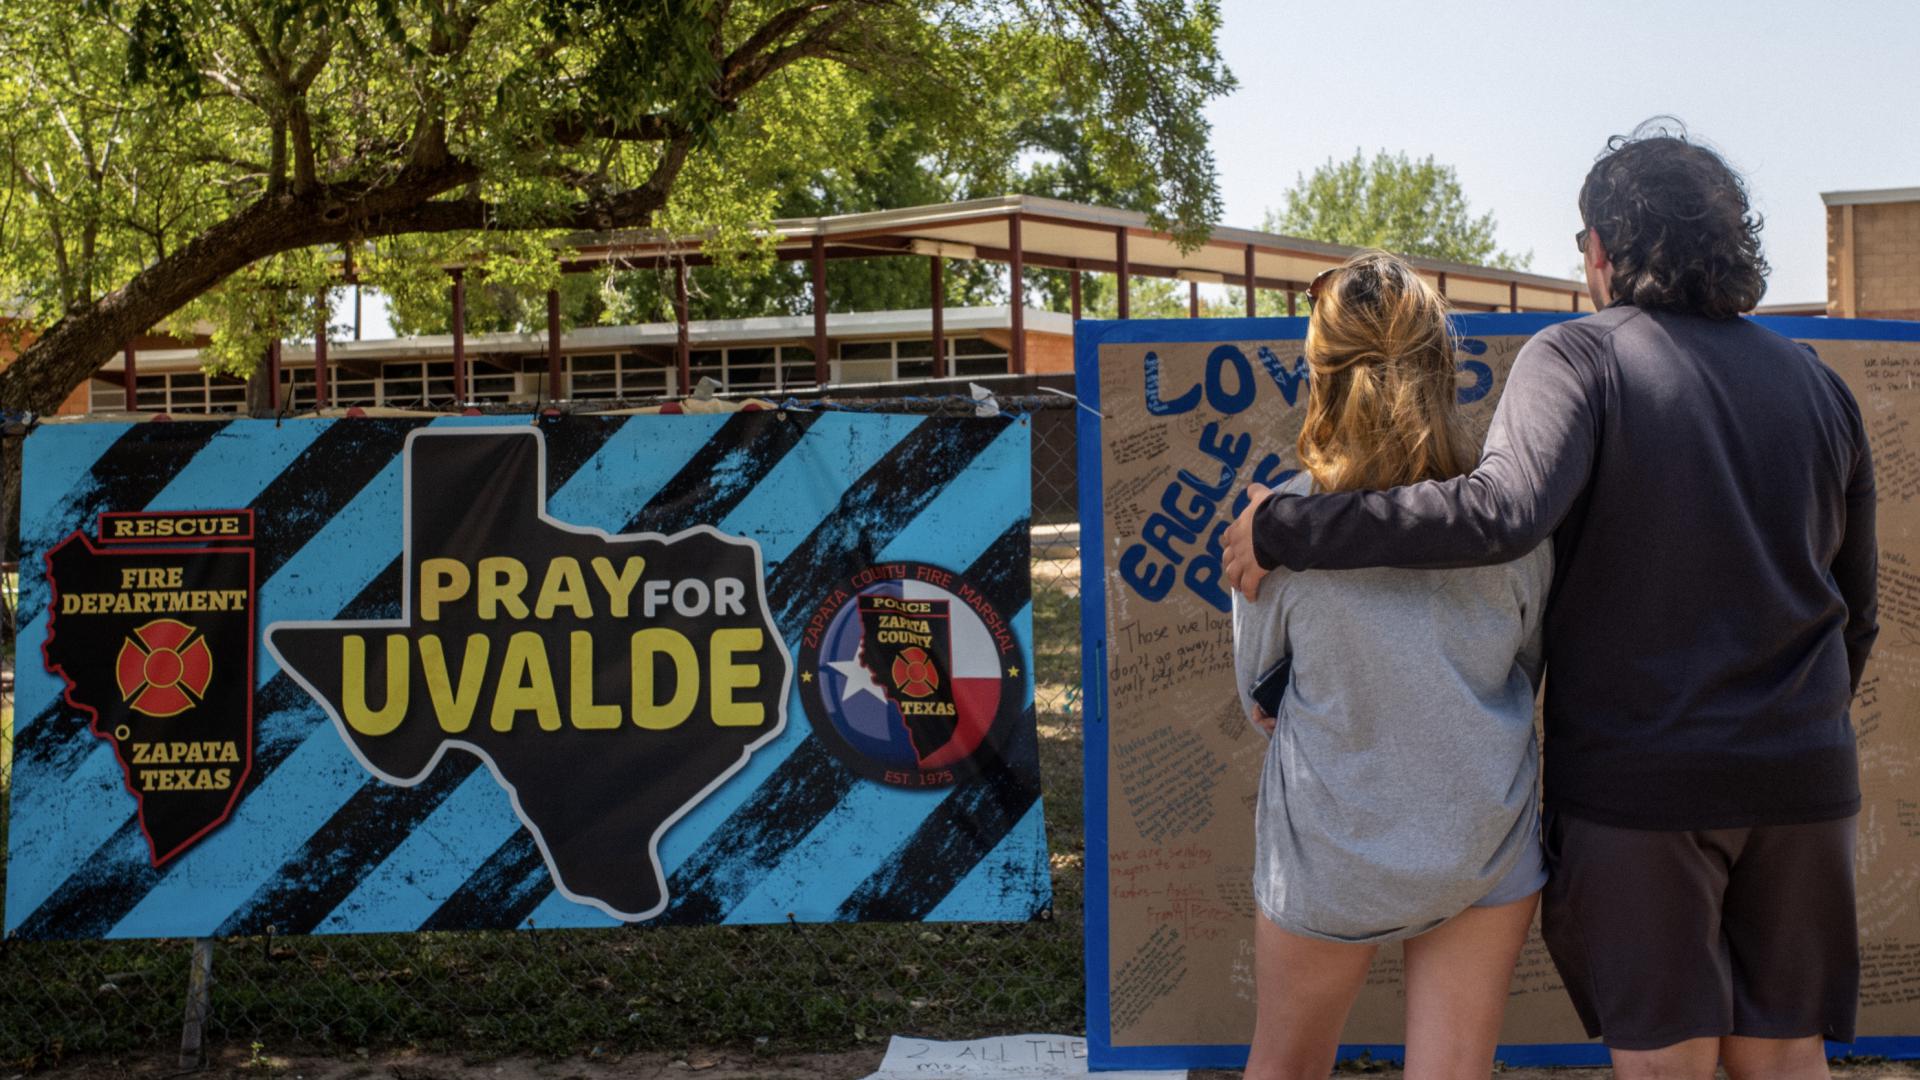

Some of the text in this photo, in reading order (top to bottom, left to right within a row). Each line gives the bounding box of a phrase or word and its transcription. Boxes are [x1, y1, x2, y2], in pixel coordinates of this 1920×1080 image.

[1119, 421, 1252, 602] EAGLE
[114, 518, 240, 537] RESCUE
[121, 567, 183, 588] FIRE
[420, 556, 746, 621] PRAY FOR
[62, 590, 247, 614] DEPARTMENT
[803, 590, 849, 649] ZAPATA
[916, 566, 953, 588] FIRE
[958, 584, 1015, 655] MARSHAL
[873, 597, 931, 613] POLICE
[879, 615, 931, 633] ZAPATA
[1119, 611, 1234, 653] Those we love
[878, 630, 932, 648] COUNTY
[1110, 653, 1149, 681] don't
[1155, 652, 1171, 671] go
[342, 627, 765, 736] UVALDE
[901, 701, 956, 716] TEXAS
[132, 741, 240, 764] ZAPATA
[140, 768, 231, 790] TEXAS
[884, 769, 954, 785] EST. 1975
[955, 1042, 1011, 1062] ALL
[1024, 1040, 1088, 1062] THE
